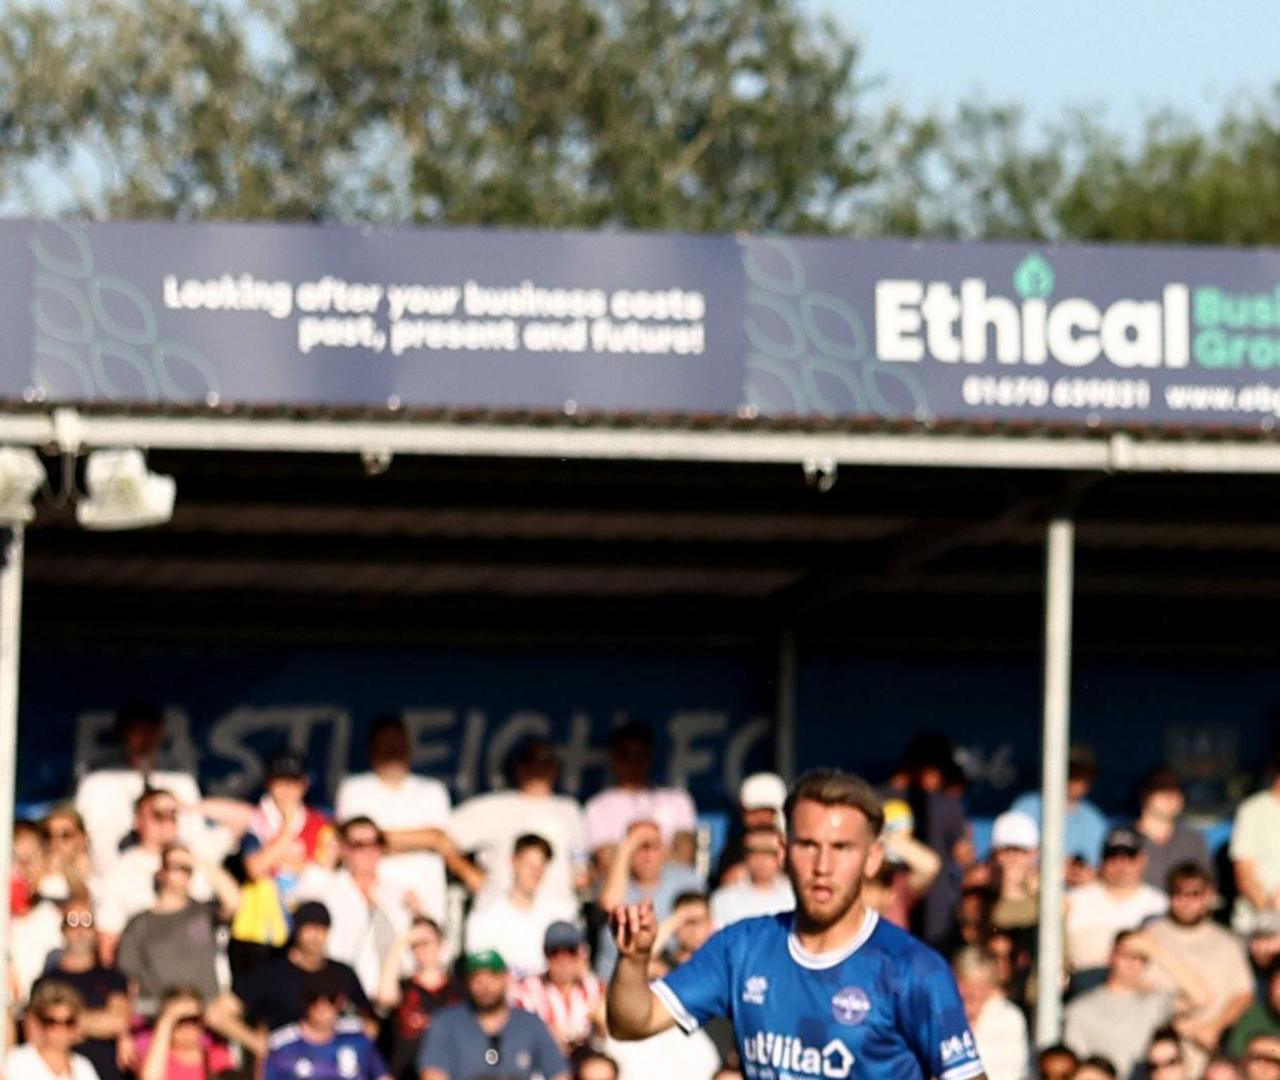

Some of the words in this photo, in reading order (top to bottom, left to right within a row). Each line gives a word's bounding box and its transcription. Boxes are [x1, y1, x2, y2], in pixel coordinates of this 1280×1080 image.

[164, 274, 292, 318] Looking
[296, 276, 383, 312] after
[387, 284, 461, 320] your
[463, 280, 606, 317] business
[611, 287, 705, 320] costs
[390, 316, 519, 355] present
[522, 317, 588, 352] and
[875, 277, 1190, 369] Ethical
